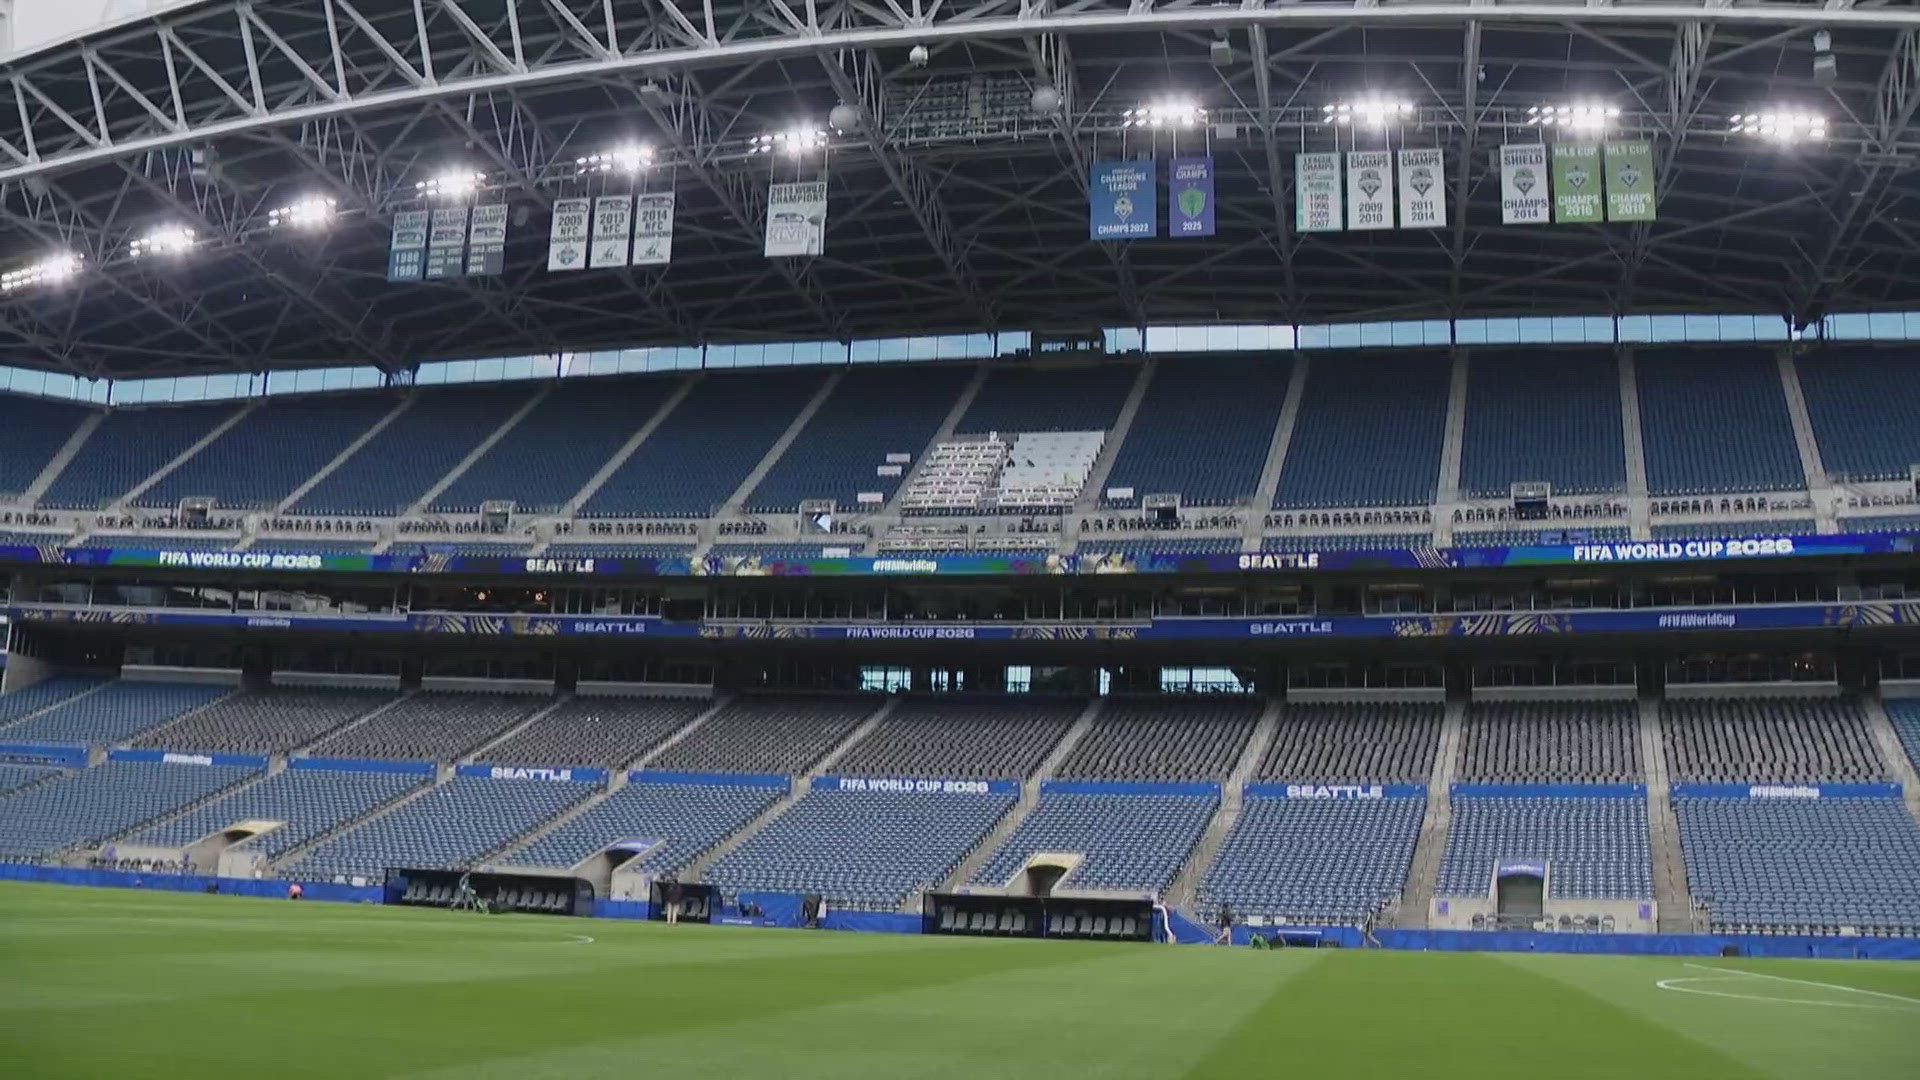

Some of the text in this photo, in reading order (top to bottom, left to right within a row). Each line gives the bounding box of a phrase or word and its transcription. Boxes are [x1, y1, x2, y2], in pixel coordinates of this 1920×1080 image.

[1577, 146, 1596, 156] CUP
[1628, 145, 1648, 154] CUP
[1351, 159, 1388, 169] CHAMPS
[1402, 157, 1440, 167] CHAMPS
[1504, 153, 1543, 165] SHIELD
[1303, 163, 1334, 172] CHAMPS
[1101, 172, 1146, 184] CHAMPIONS
[1176, 169, 1207, 180] CHAMPS
[1109, 182, 1137, 192] LEAGUE
[770, 191, 825, 205] CHAMPIONS
[1558, 194, 1599, 205] CHAMPS
[1610, 193, 1651, 204] CHAMPS
[1359, 202, 1383, 212] 2009
[1411, 201, 1433, 211] 2011
[1504, 199, 1547, 209] CHAMPS
[600, 213, 625, 224] 2013
[642, 210, 667, 221] 2014
[1359, 213, 1383, 223] 2010
[1411, 211, 1435, 221] 2014
[1513, 208, 1538, 219] 2014
[558, 215, 582, 226] 2005
[645, 221, 663, 230] NFC
[1182, 221, 1202, 231] 2025
[561, 227, 578, 235] NFC
[603, 224, 620, 233] NFC
[1098, 223, 1149, 235] CHAMPS 2022
[1573, 539, 1794, 561] FIFA WORLD CUP 2026
[159, 551, 322, 569] FIFA WORLD CUP 2026
[1239, 553, 1319, 569] SEATTLE
[526, 559, 594, 573] SEATTLE
[1659, 612, 1735, 628] #FIFAWorldCup
[574, 622, 645, 633] SEATTLE
[846, 628, 975, 638] FIFA WORLD CUP 2026
[1250, 622, 1332, 634] SEATTLE
[490, 767, 572, 781] SEATTLE
[839, 778, 989, 793] FIFA WORLD CUP 2026
[1286, 784, 1383, 800] SEATTLE
